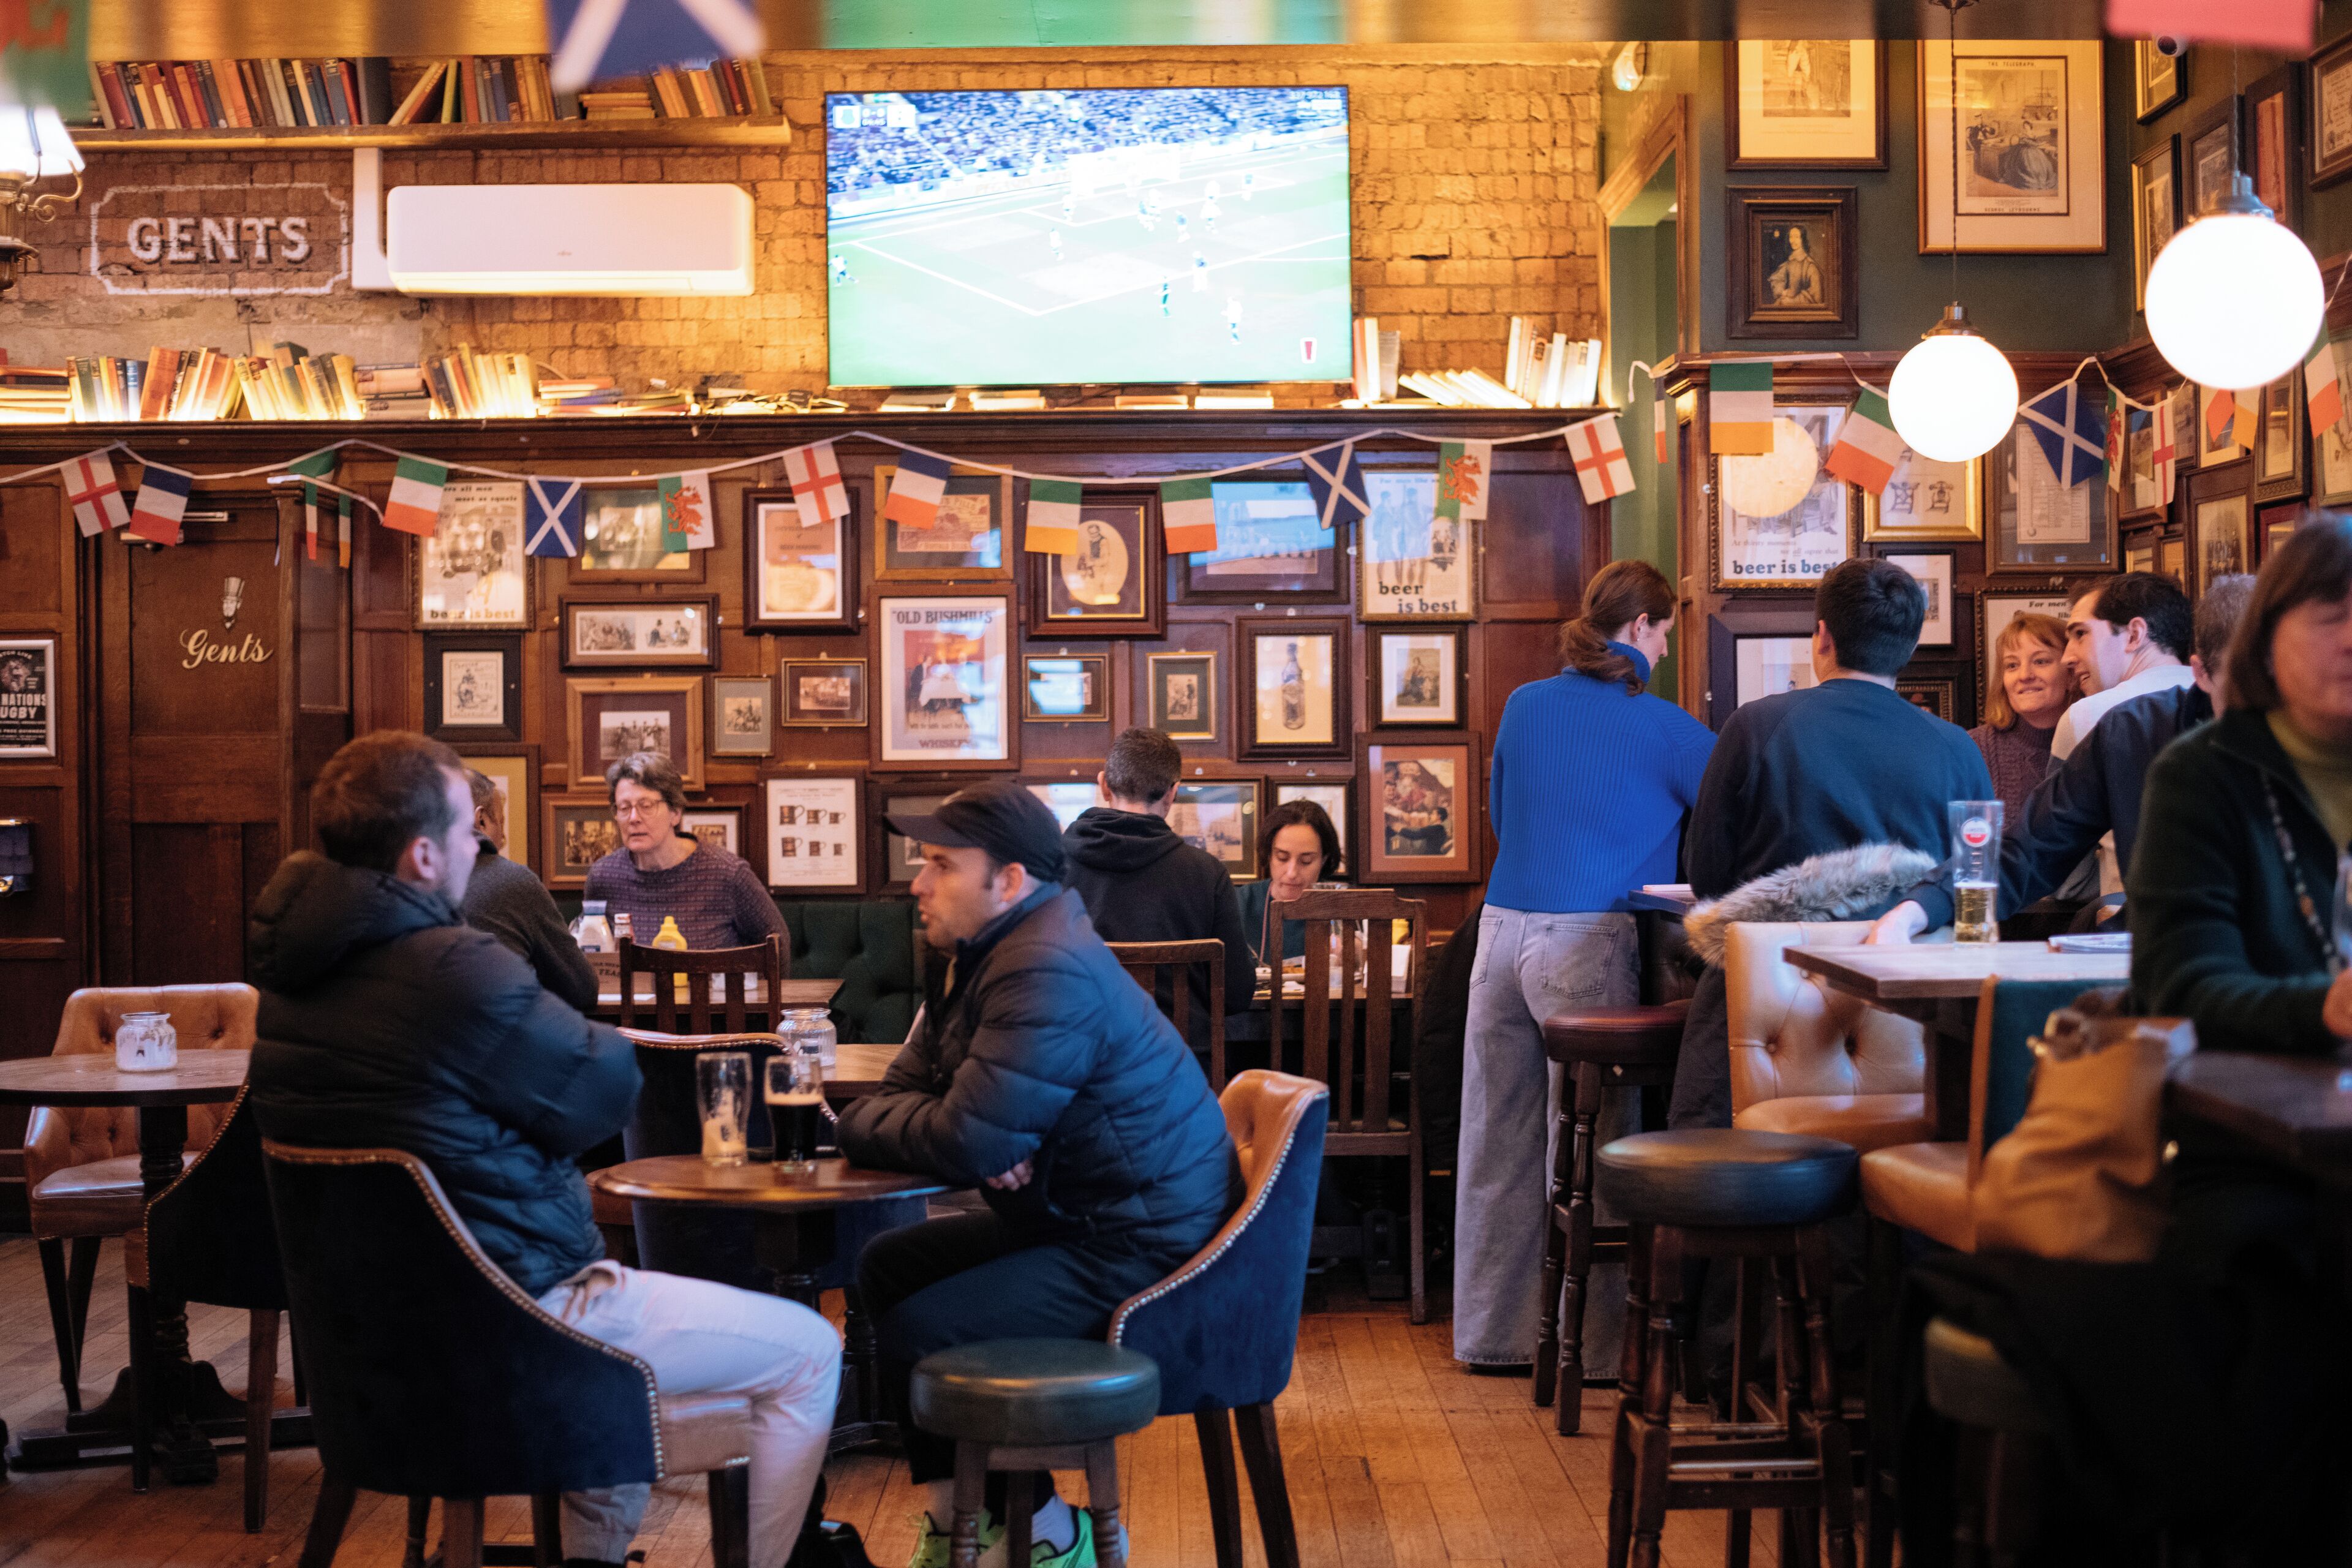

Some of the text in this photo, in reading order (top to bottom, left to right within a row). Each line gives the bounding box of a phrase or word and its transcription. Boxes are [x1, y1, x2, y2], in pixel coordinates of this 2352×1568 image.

[127, 216, 312, 263] GENTS
[1733, 560, 1776, 575] beer
[1781, 559, 1796, 574] is
[1379, 581, 1423, 595] beer
[1398, 598, 1458, 613] is best
[484, 608, 515, 619] best
[179, 628, 274, 669] Gents
[1, 693, 47, 706] NATIONS
